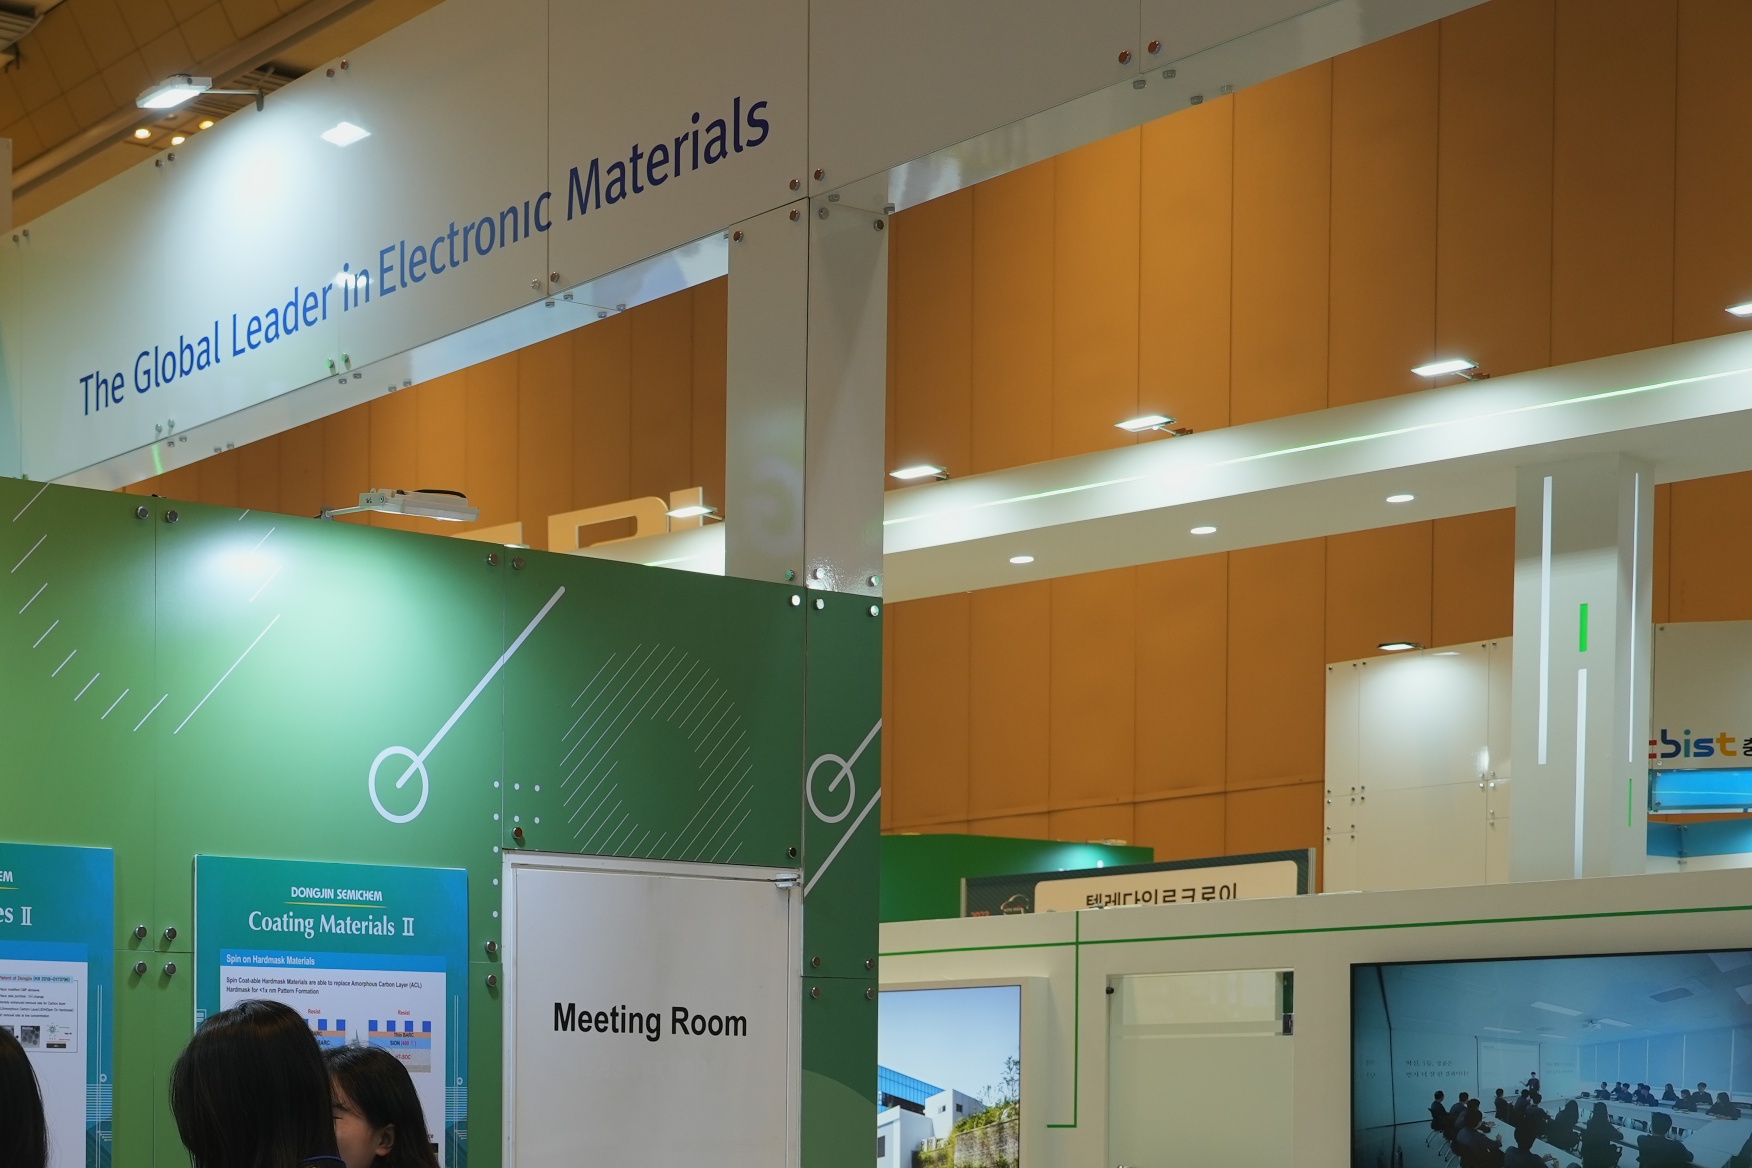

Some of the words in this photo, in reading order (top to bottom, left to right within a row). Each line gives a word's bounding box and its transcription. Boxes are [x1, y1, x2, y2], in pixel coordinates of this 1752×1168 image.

[79, 373, 125, 417] The
[132, 320, 221, 395] Global
[232, 281, 334, 357] Leader
[342, 262, 372, 312] in
[378, 191, 553, 296] Electronic
[565, 96, 771, 221] Materials
[291, 887, 334, 900] DONGJIN
[337, 889, 382, 901] SEMICHEM
[249, 911, 314, 939] Coating
[320, 914, 395, 936] Materials
[227, 954, 242, 964] Spin
[253, 955, 285, 965] Hardmask
[287, 956, 315, 965] Materials
[334, 980, 350, 988] replace
[351, 980, 378, 988] Amorphous
[554, 1002, 661, 1042] Meeting
[672, 1007, 747, 1037] Room
